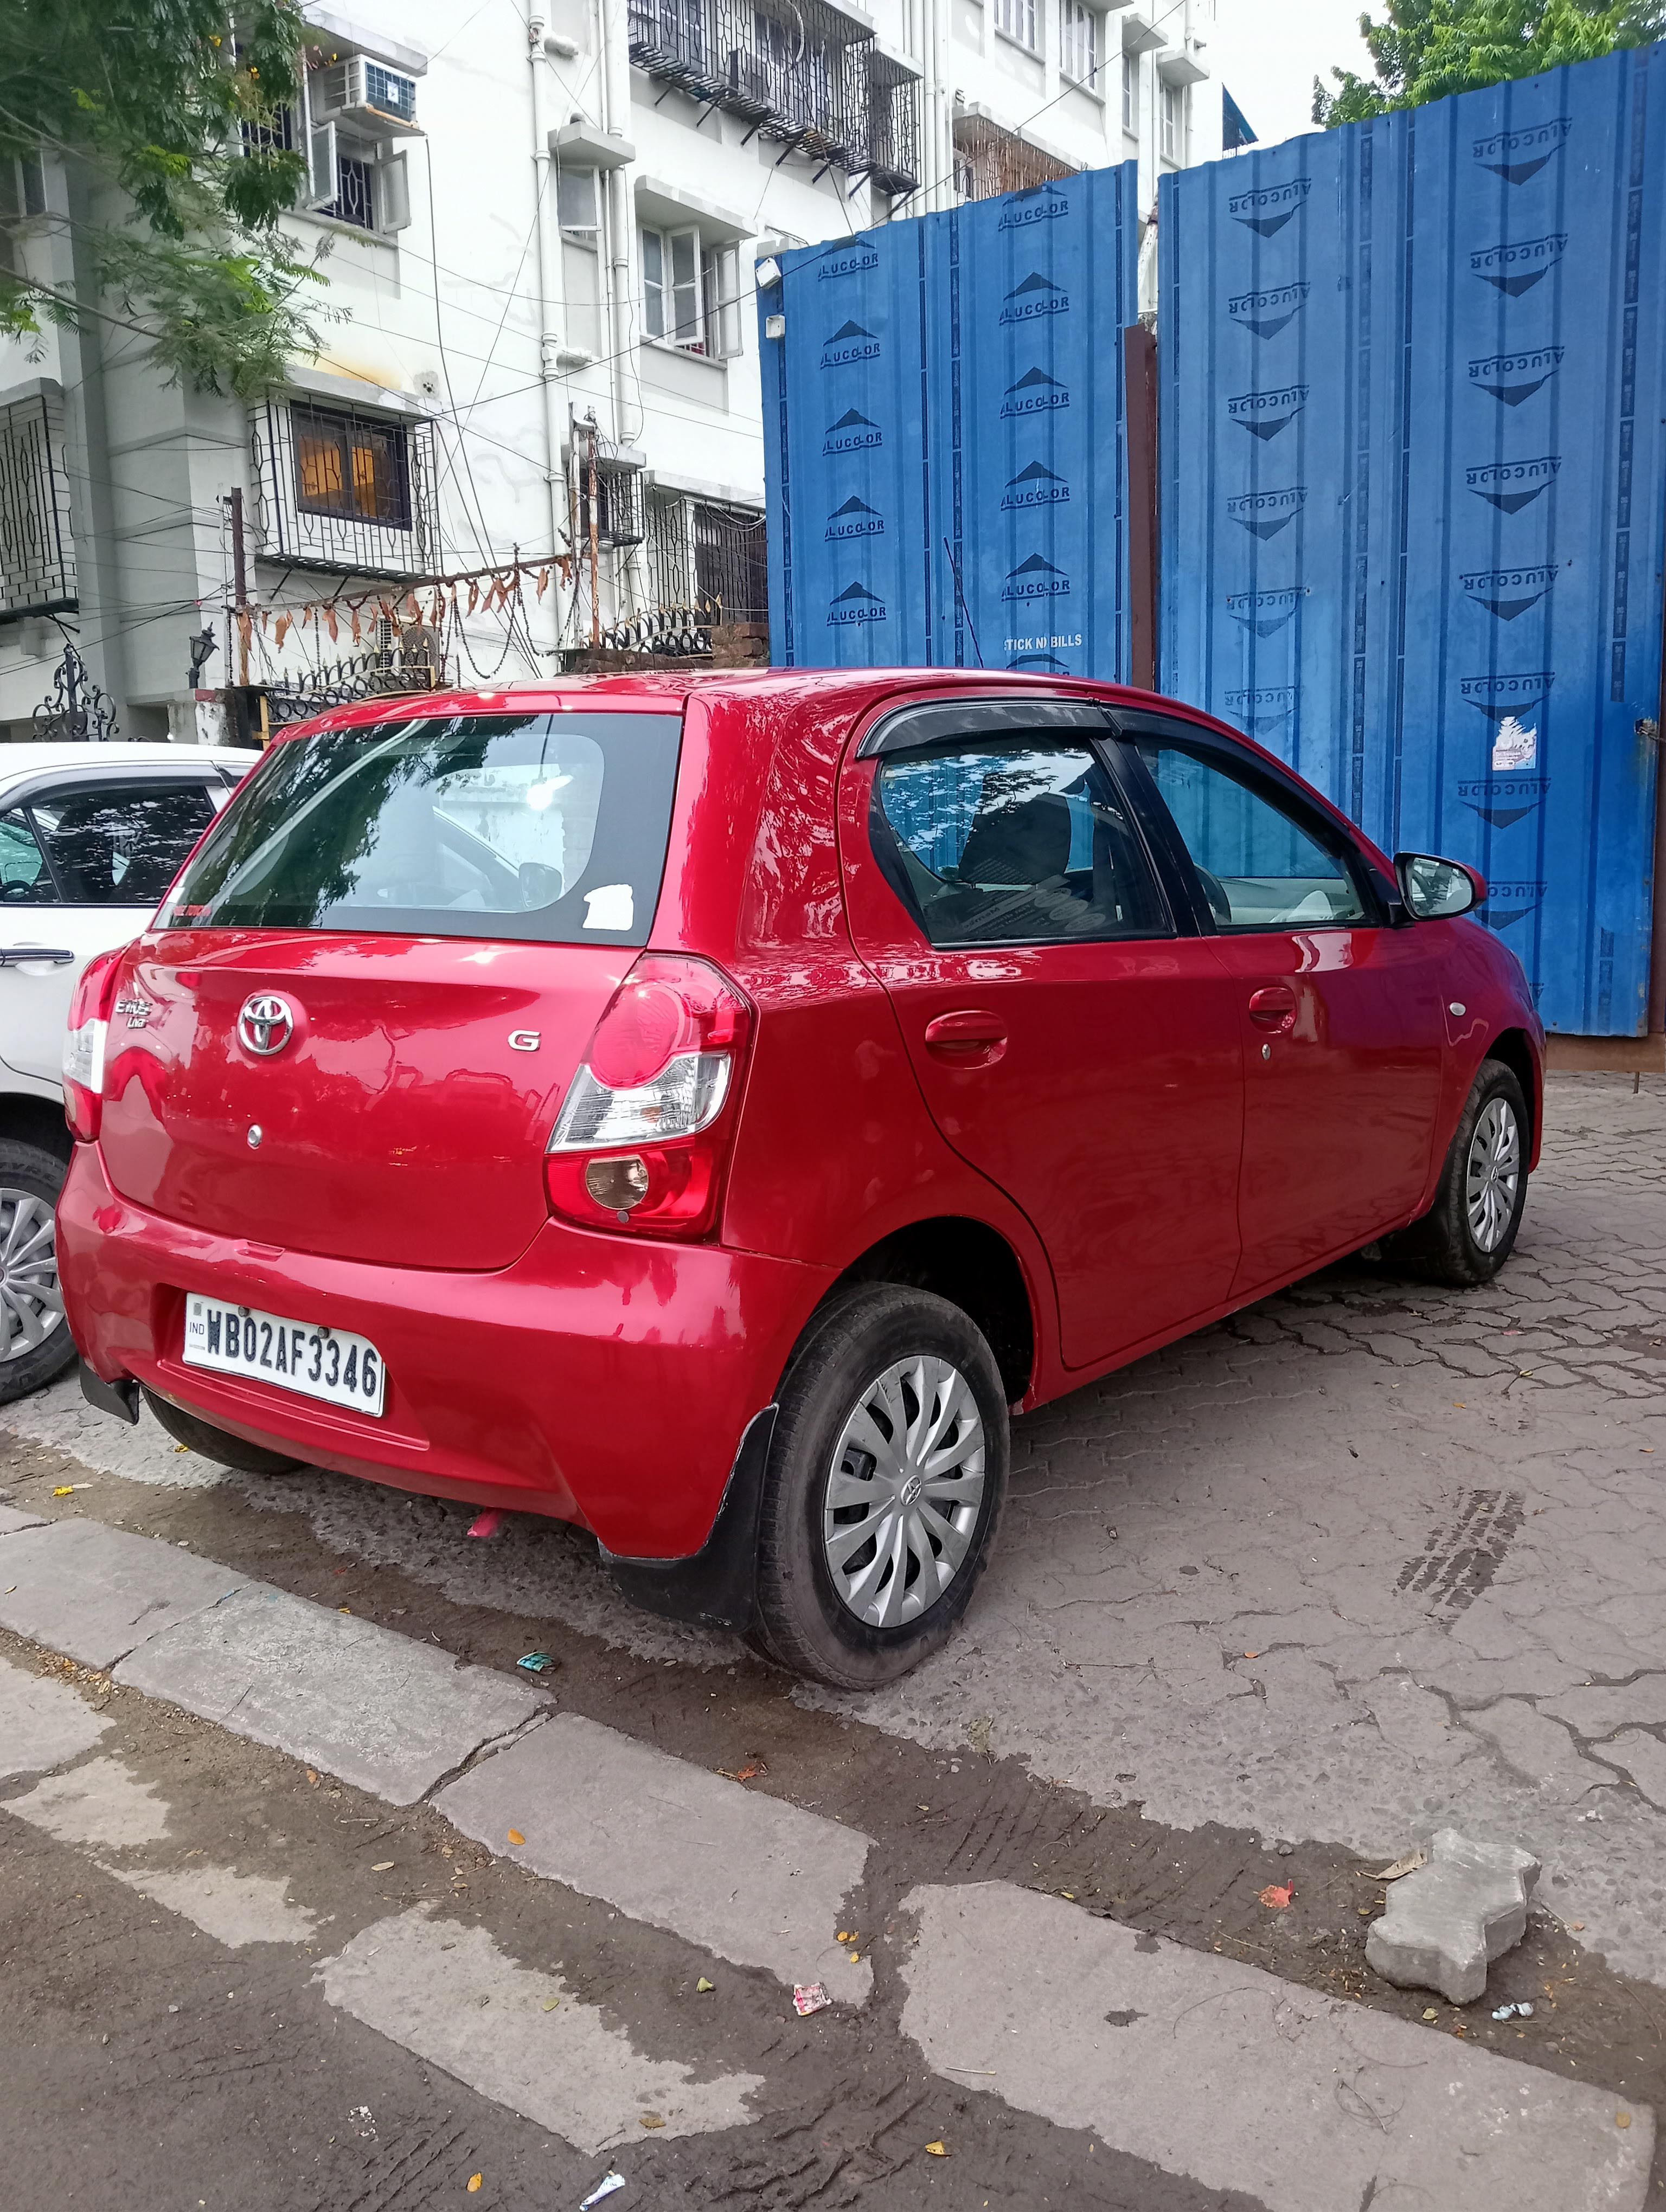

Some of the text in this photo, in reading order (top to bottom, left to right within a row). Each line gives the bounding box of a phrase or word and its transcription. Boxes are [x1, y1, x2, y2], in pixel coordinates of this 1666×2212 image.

[1050, 633, 1082, 648] BILLS
[507, 1029, 541, 1052] G
[189, 1322, 205, 1336] IND
[207, 1309, 377, 1397] WB02AF3346
